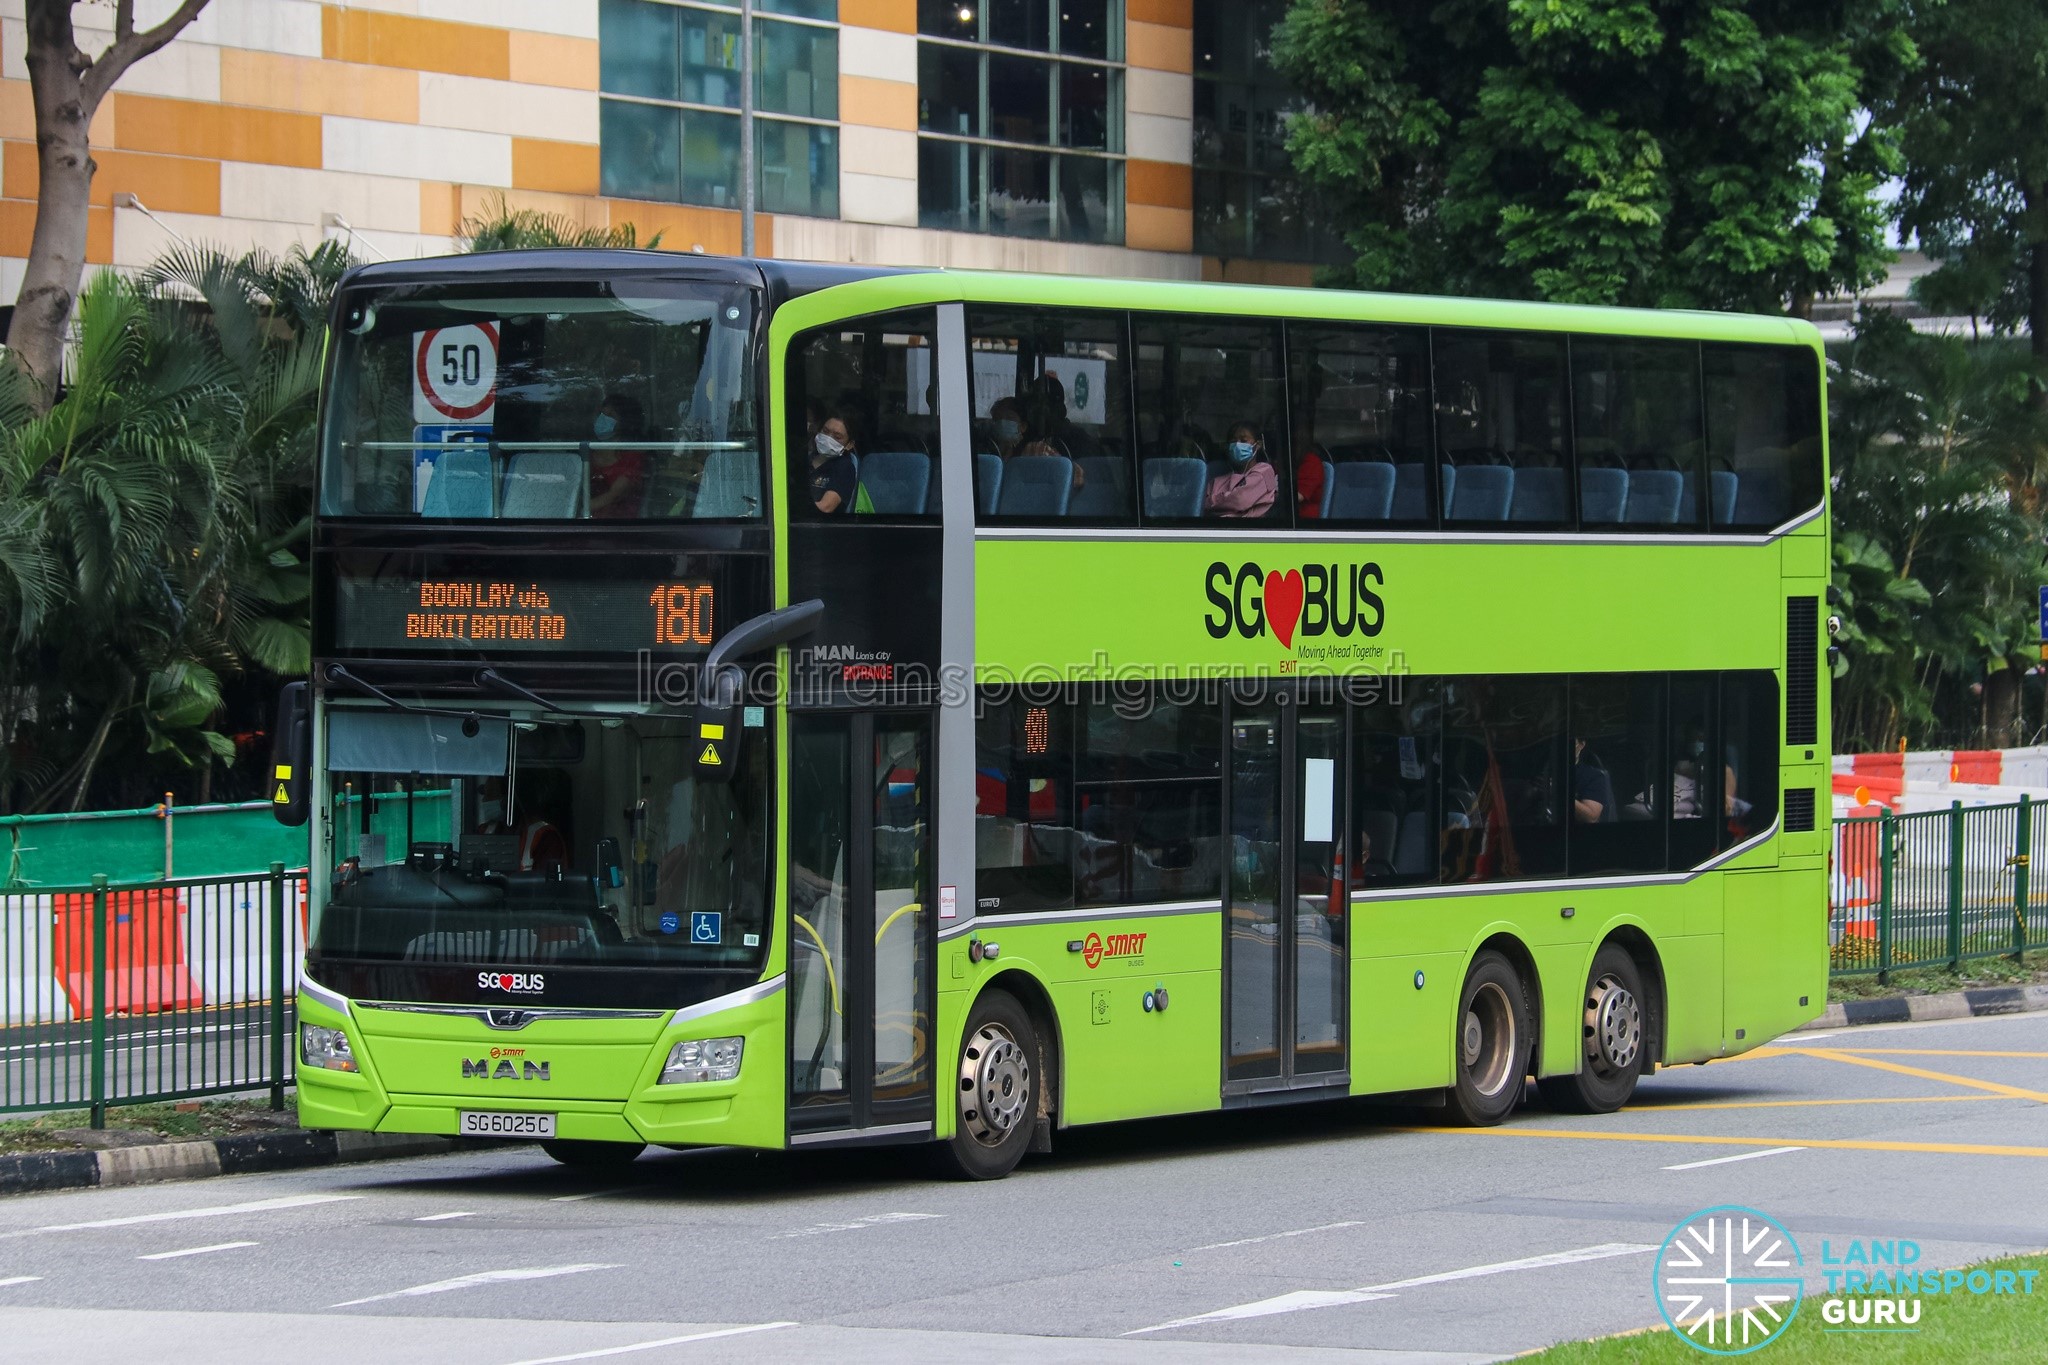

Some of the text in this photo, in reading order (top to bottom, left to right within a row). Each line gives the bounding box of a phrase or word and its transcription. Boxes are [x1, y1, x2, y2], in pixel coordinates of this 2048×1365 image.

[443, 344, 480, 386] 50
[420, 582, 550, 608] BOON LAY via
[649, 585, 714, 645] 180
[406, 614, 566, 640] BUKIT BATOK RD
[813, 645, 892, 661] MAN Lion's City
[1297, 644, 1384, 661] Moving Ahead Together
[843, 665, 893, 680] ENTRANCE
[1280, 660, 1297, 673] EXIT
[1024, 708, 1048, 753] 180
[1104, 933, 1147, 956] SMRT
[462, 1058, 551, 1081] MAN
[467, 1114, 549, 1133] SG6025C
